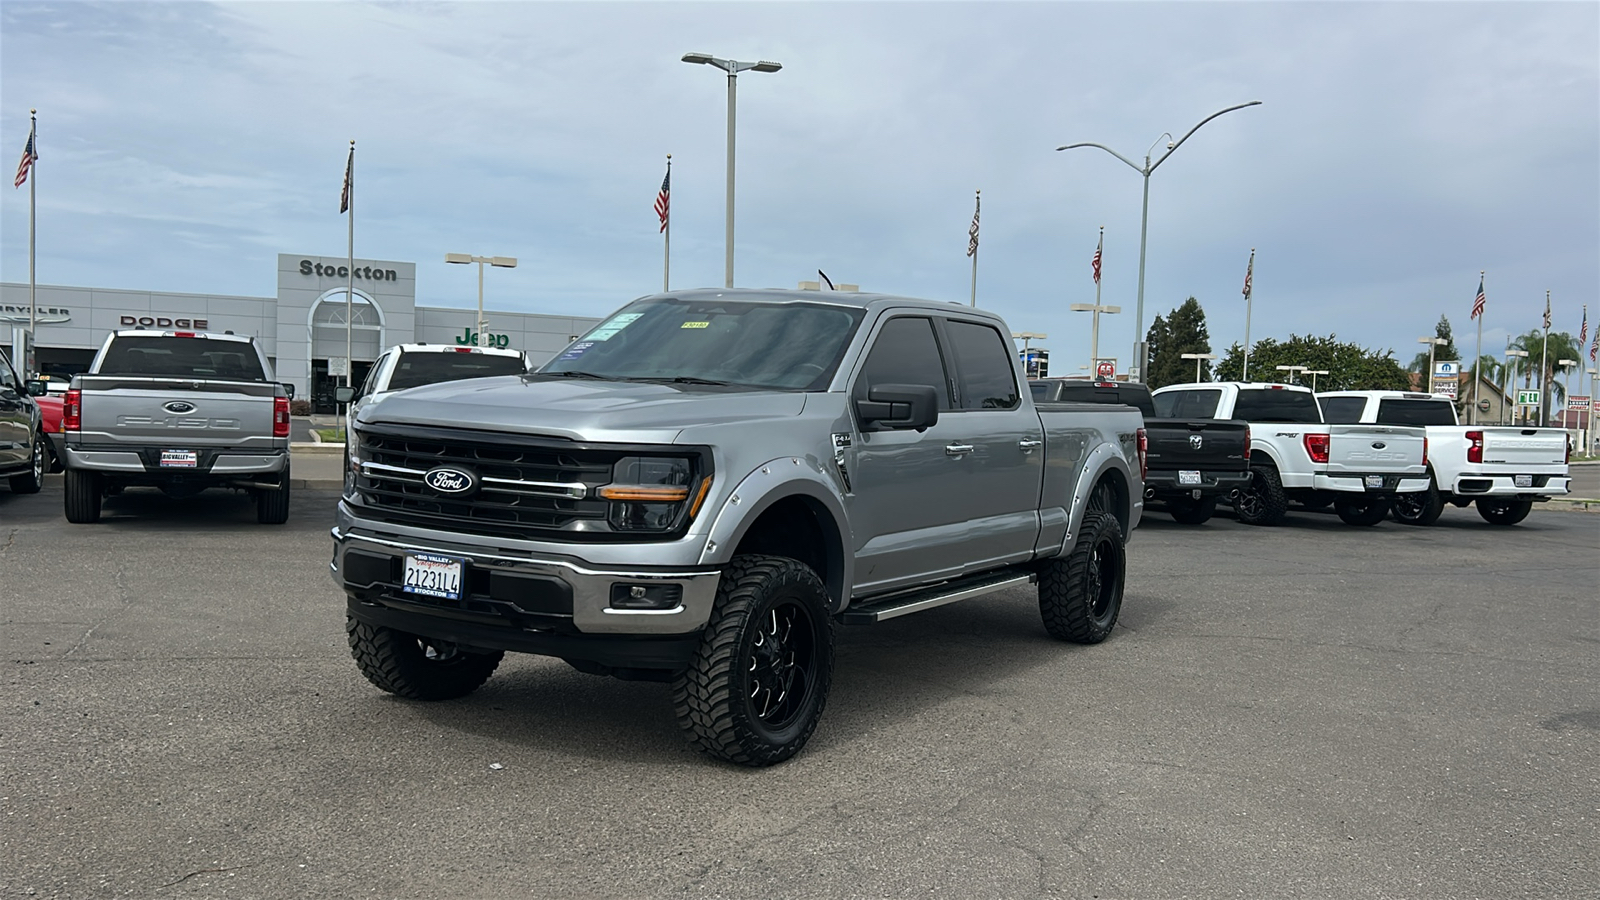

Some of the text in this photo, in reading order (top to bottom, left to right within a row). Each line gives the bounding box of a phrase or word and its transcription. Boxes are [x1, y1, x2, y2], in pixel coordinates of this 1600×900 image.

[299, 259, 397, 281] Stockton
[120, 316, 209, 329] DODGE
[1528, 392, 1539, 403] EV
[116, 415, 241, 430] F-150
[432, 471, 464, 489] Ford
[406, 567, 458, 593] 21231L4
[414, 587, 448, 598] STOCKTON
